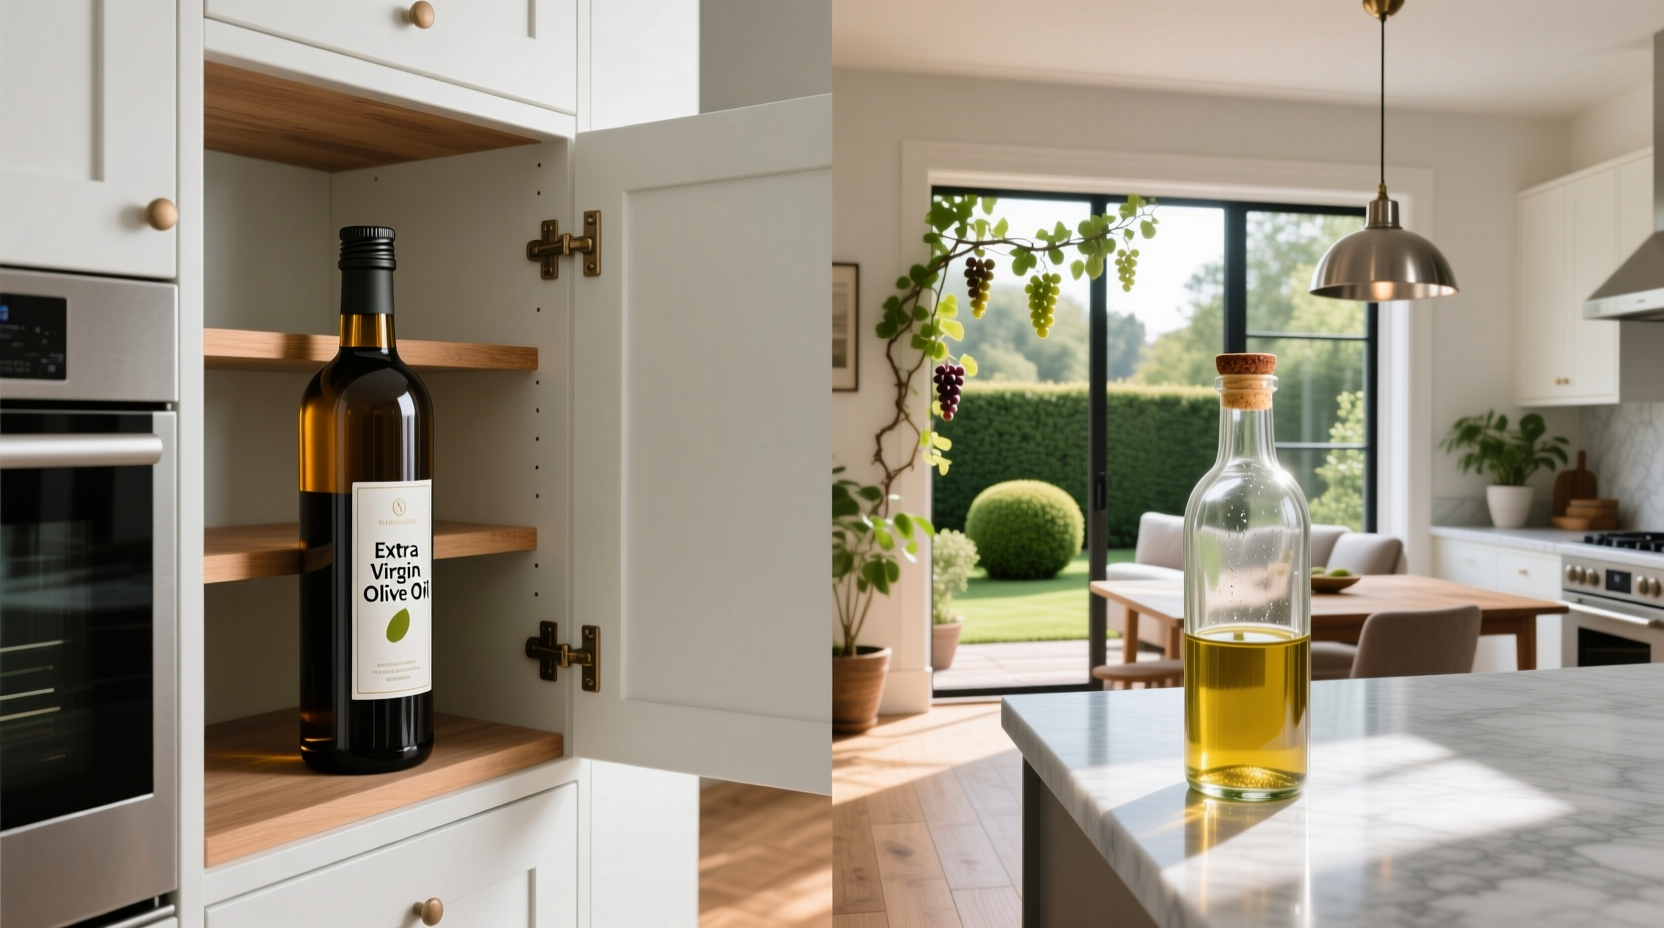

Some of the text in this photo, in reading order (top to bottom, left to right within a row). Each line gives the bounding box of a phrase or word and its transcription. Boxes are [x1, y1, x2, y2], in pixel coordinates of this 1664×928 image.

[374, 541, 419, 559] Extra
[370, 561, 421, 585] Virgin
[363, 579, 430, 603] Olive Oil
